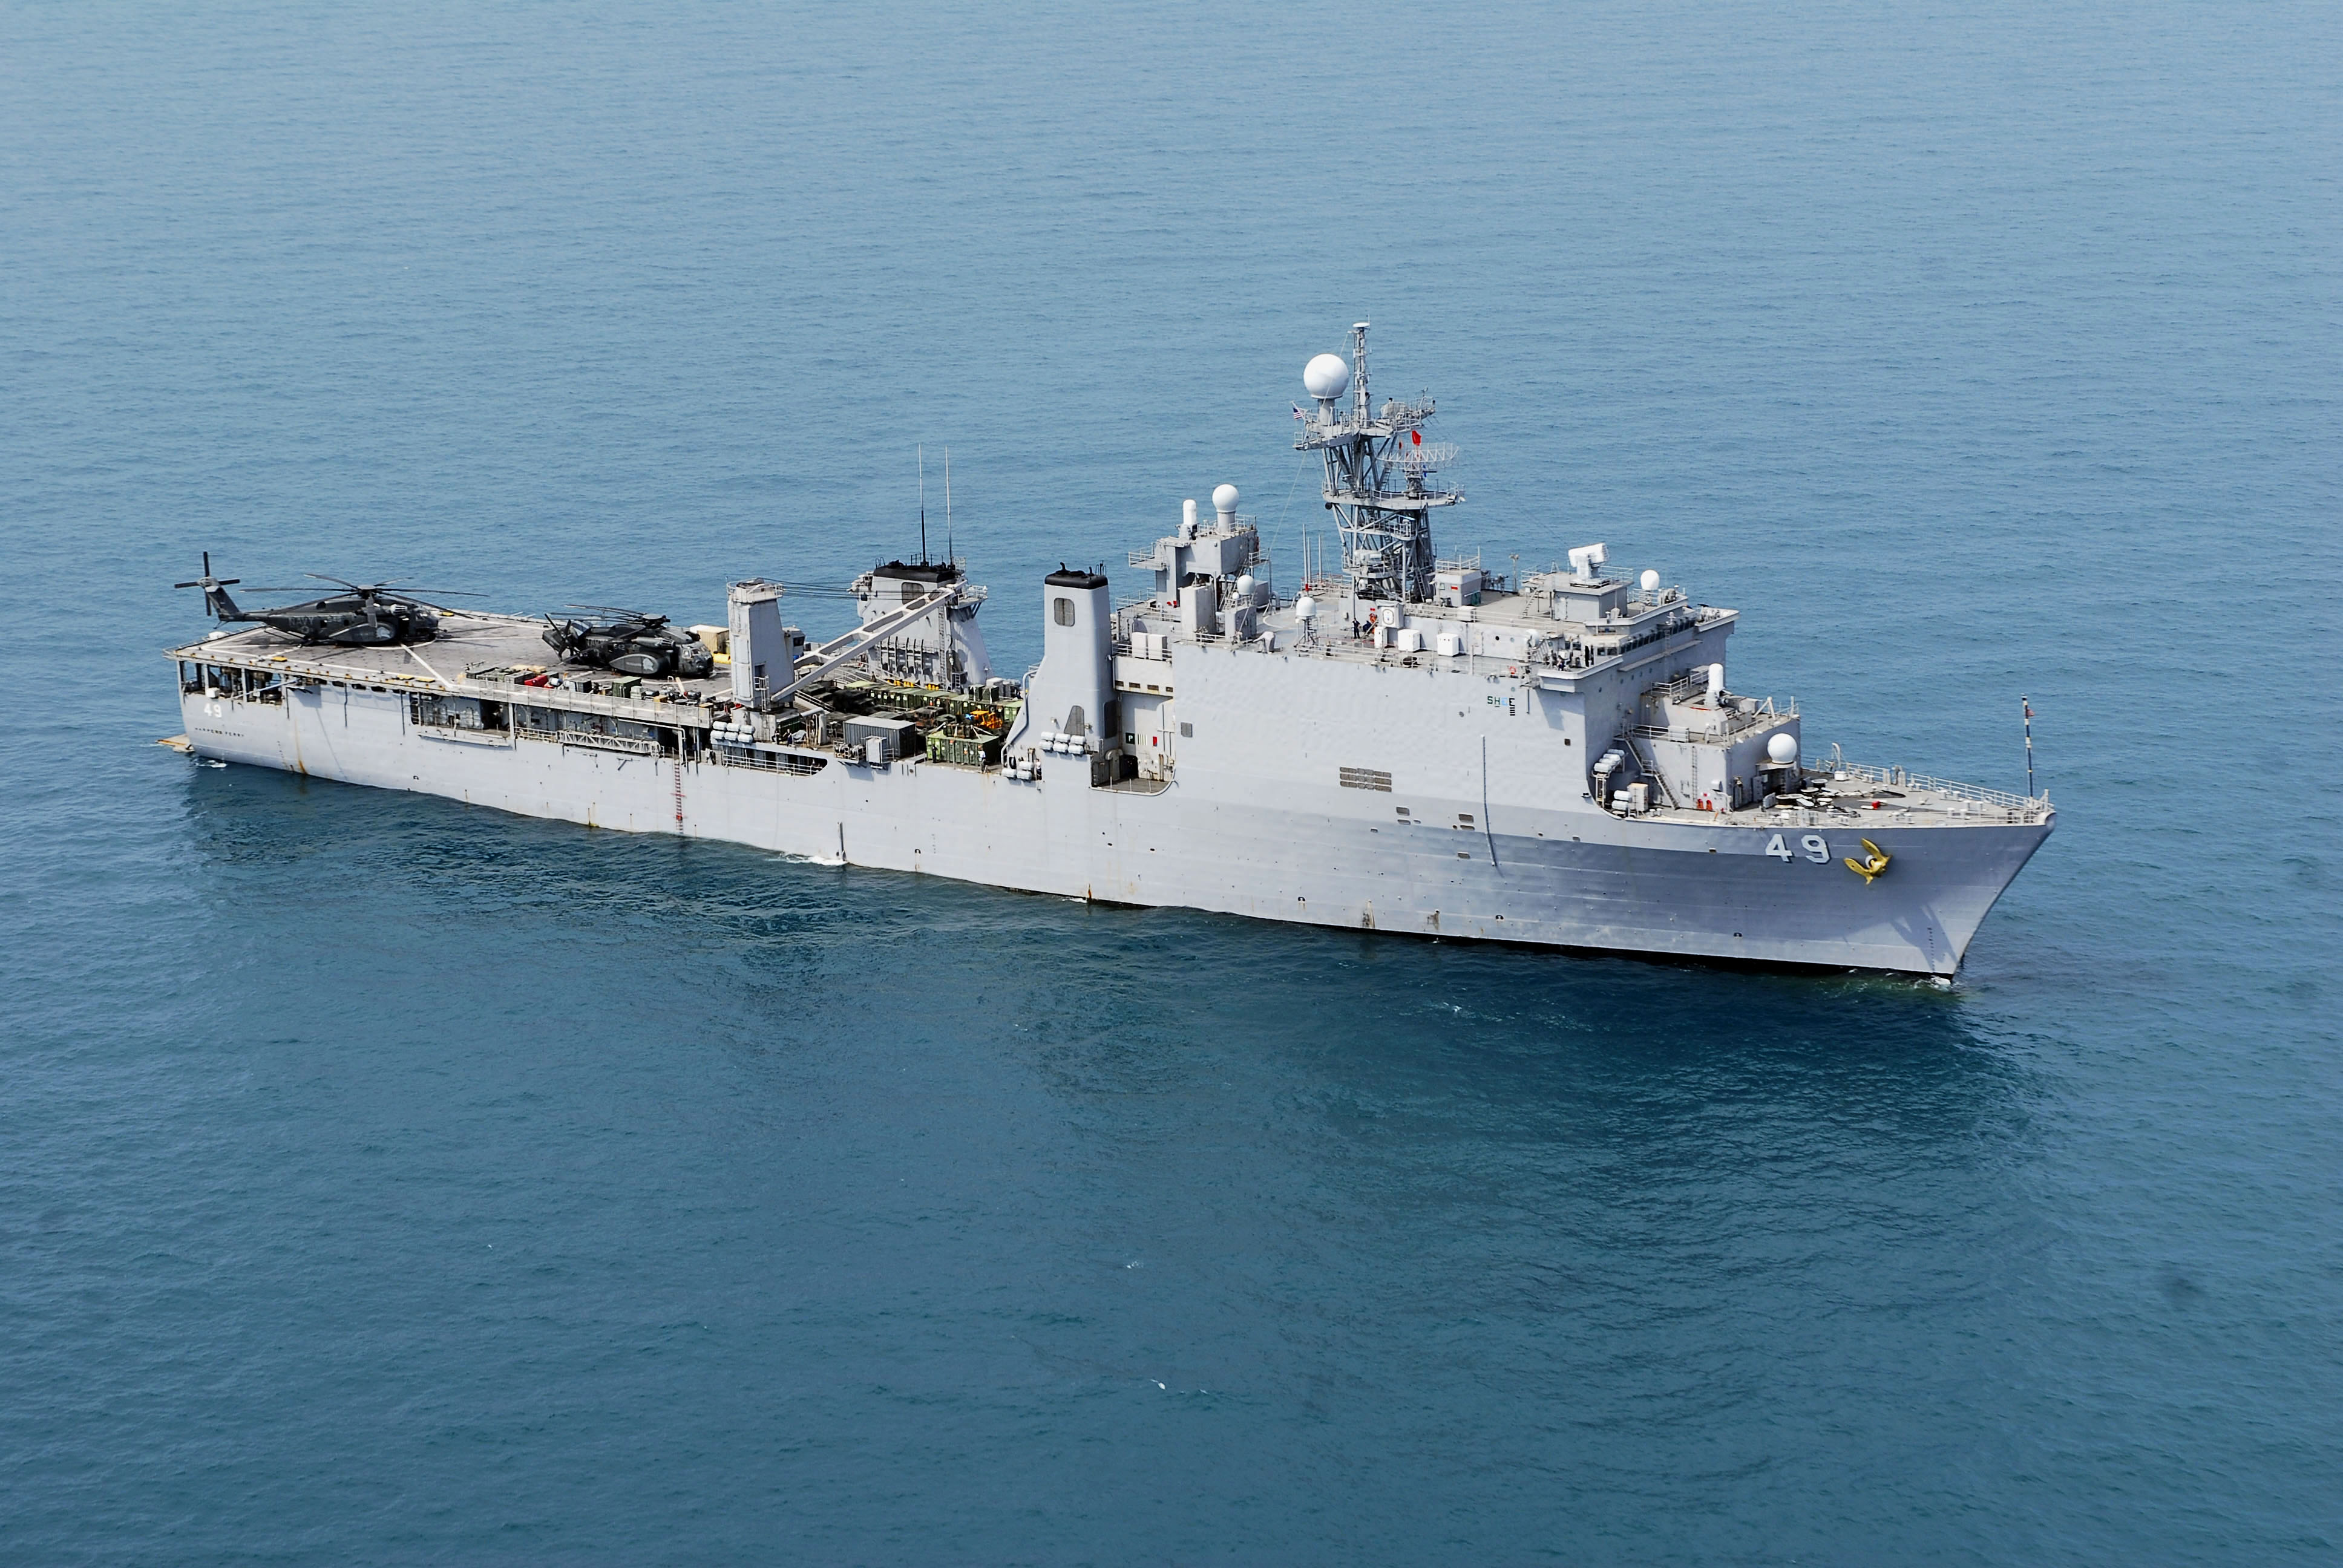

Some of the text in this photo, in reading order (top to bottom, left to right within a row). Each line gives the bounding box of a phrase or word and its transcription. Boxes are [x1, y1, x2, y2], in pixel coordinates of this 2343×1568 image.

[288, 617, 315, 626] NAVY
[204, 703, 222, 717] 49
[1765, 834, 1830, 863] 49
